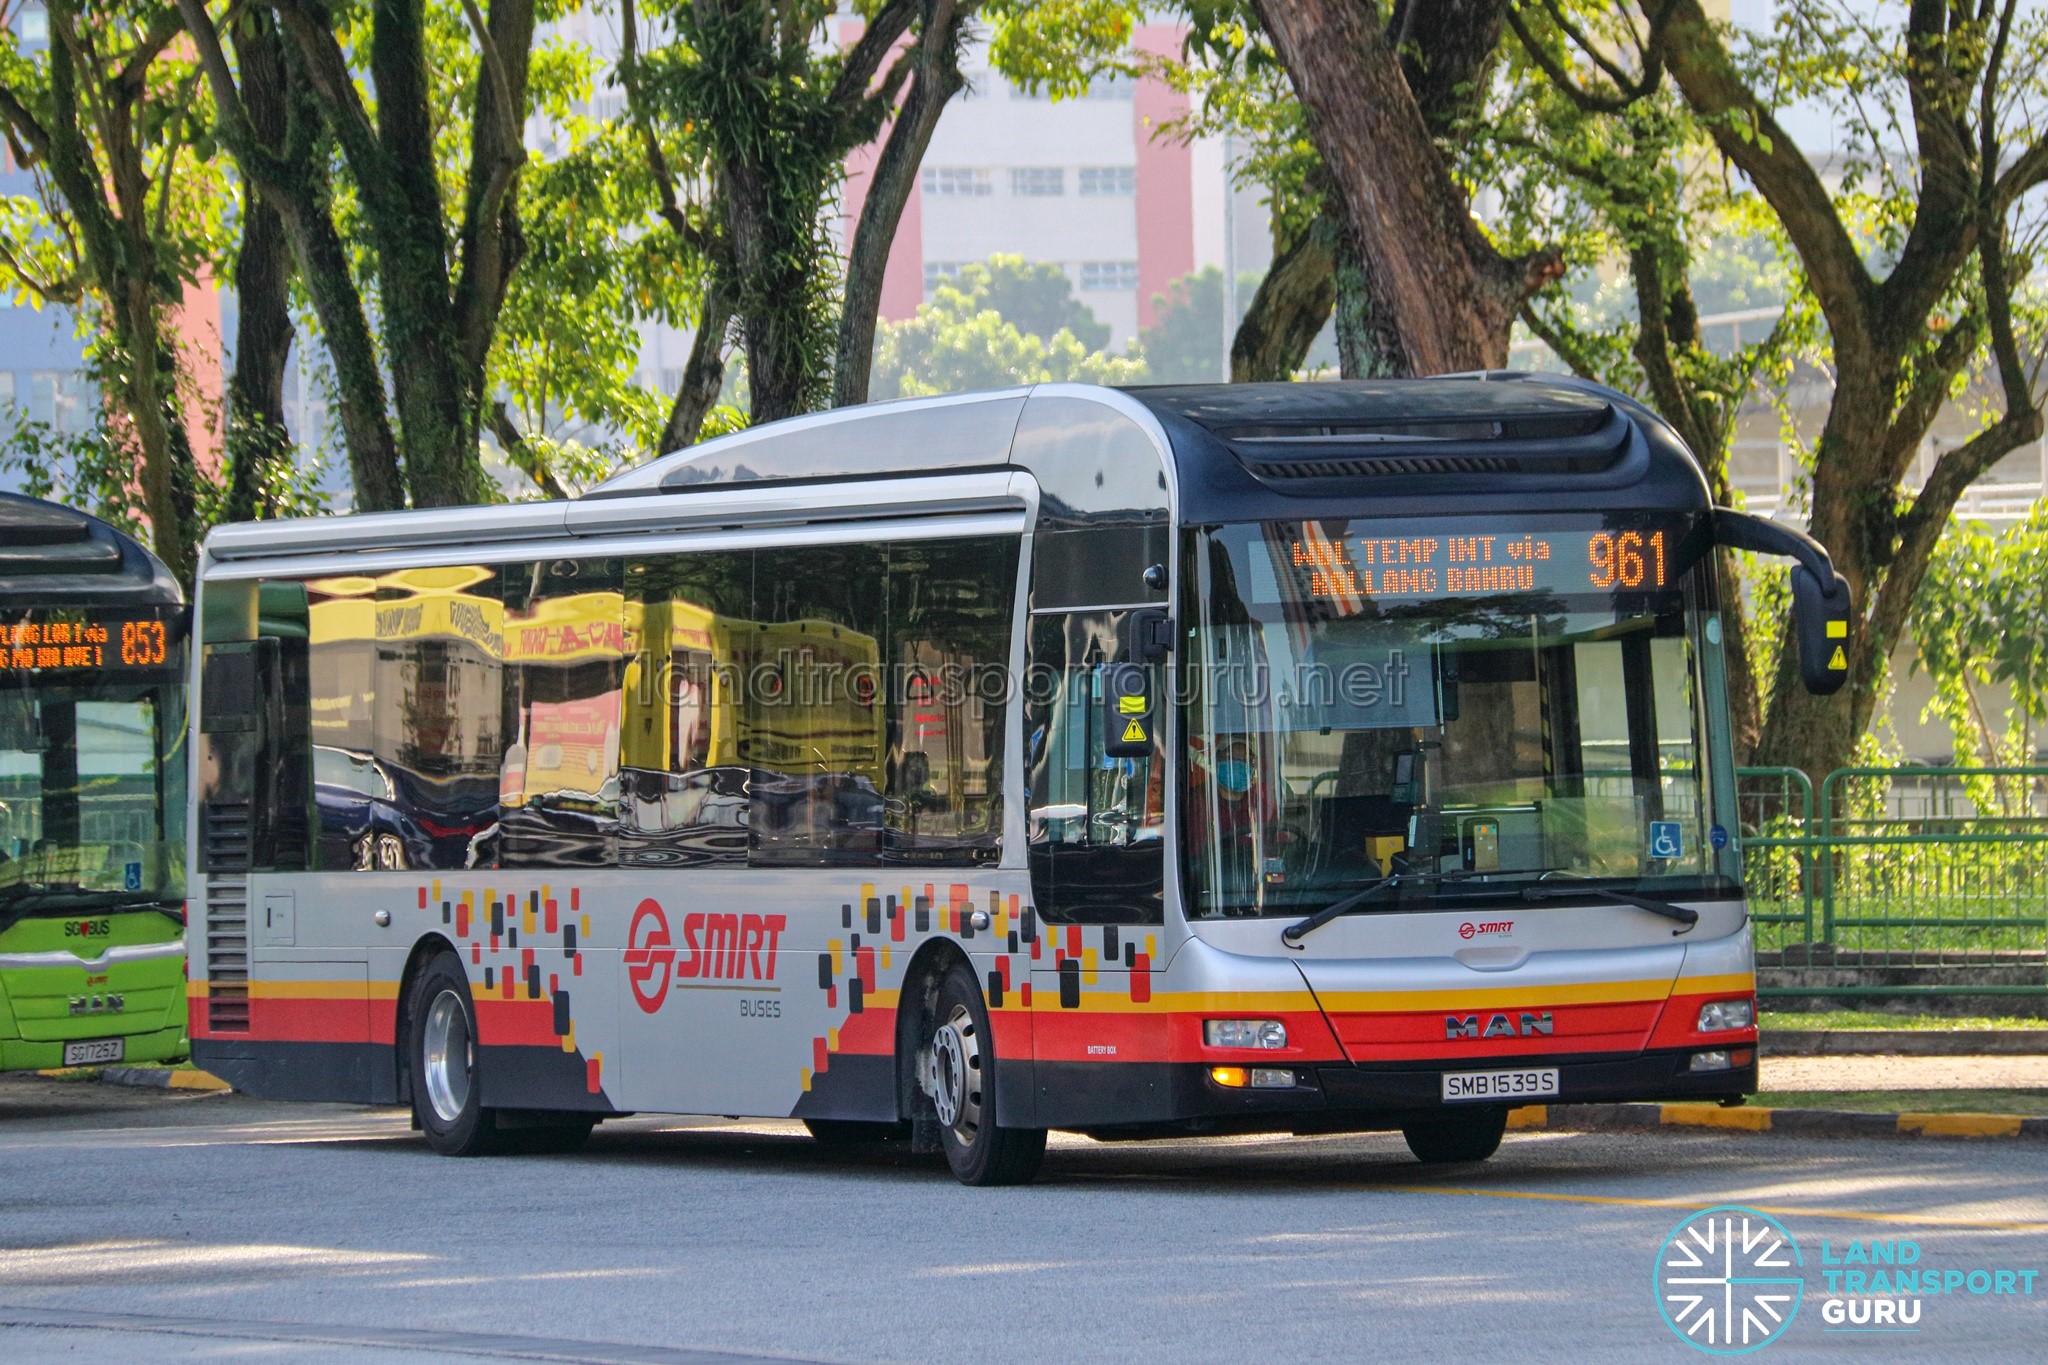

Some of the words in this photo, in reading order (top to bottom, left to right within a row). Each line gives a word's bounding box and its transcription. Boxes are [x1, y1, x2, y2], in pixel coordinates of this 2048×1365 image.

[1293, 541, 1351, 566] WDL
[1361, 538, 1438, 564] TEMP
[1448, 536, 1496, 562] INT
[1506, 535, 1551, 560] via
[1588, 531, 1665, 588] 961
[1447, 565, 1534, 592] BAHRU
[121, 621, 166, 665] 853
[1477, 921, 1514, 934] SMRT
[676, 912, 787, 981] SMRT
[740, 999, 781, 1019] BUSES
[1445, 1011, 1554, 1040] MAN
[71, 1042, 118, 1061] SG1725Z
[1087, 1045, 1106, 1055] BATTERY
[1106, 1045, 1117, 1055] BOX
[1448, 1072, 1554, 1096] SMB1539S
